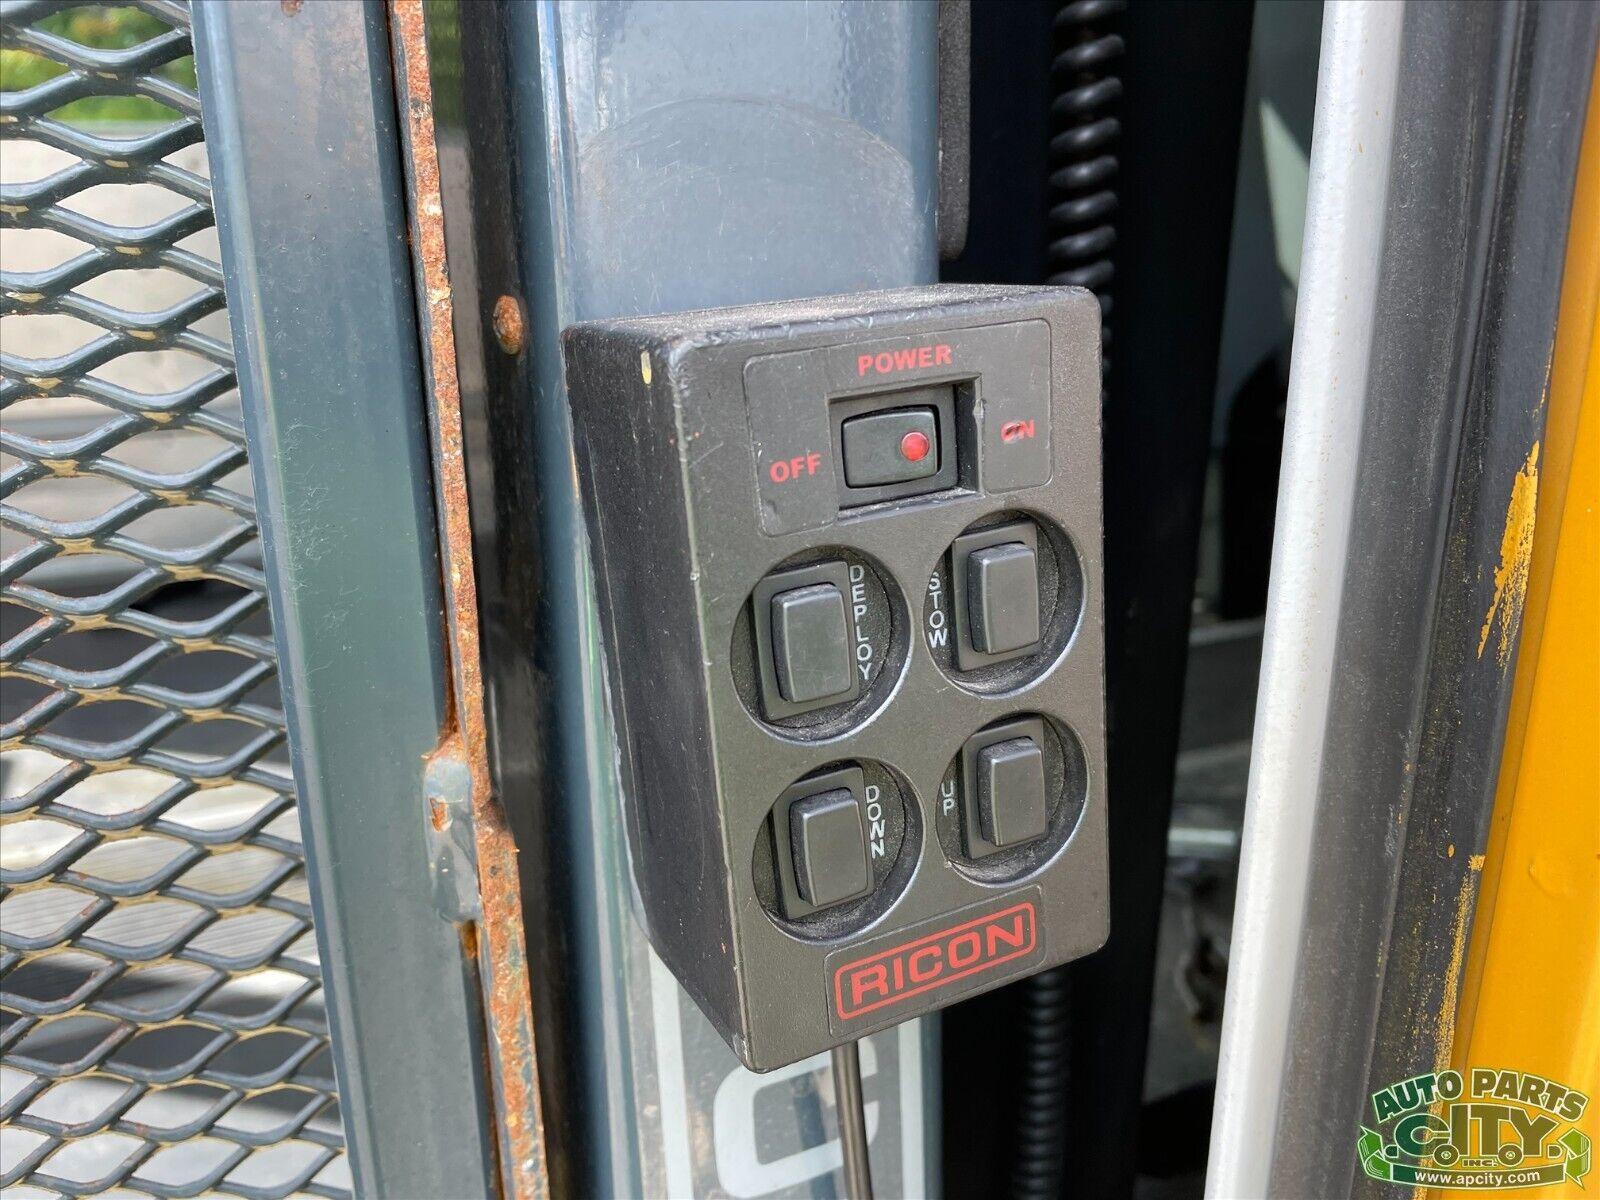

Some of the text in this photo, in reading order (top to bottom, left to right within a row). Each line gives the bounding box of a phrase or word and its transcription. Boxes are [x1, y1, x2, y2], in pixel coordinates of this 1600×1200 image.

[857, 344, 953, 377] POWER
[1000, 419, 1036, 444] ON
[769, 453, 822, 484] OFF
[849, 564, 873, 681] DEPLOY
[928, 571, 948, 649] STOW
[865, 784, 886, 860] DOWN
[941, 780, 956, 817] UP
[851, 915, 1024, 1006] RICON
